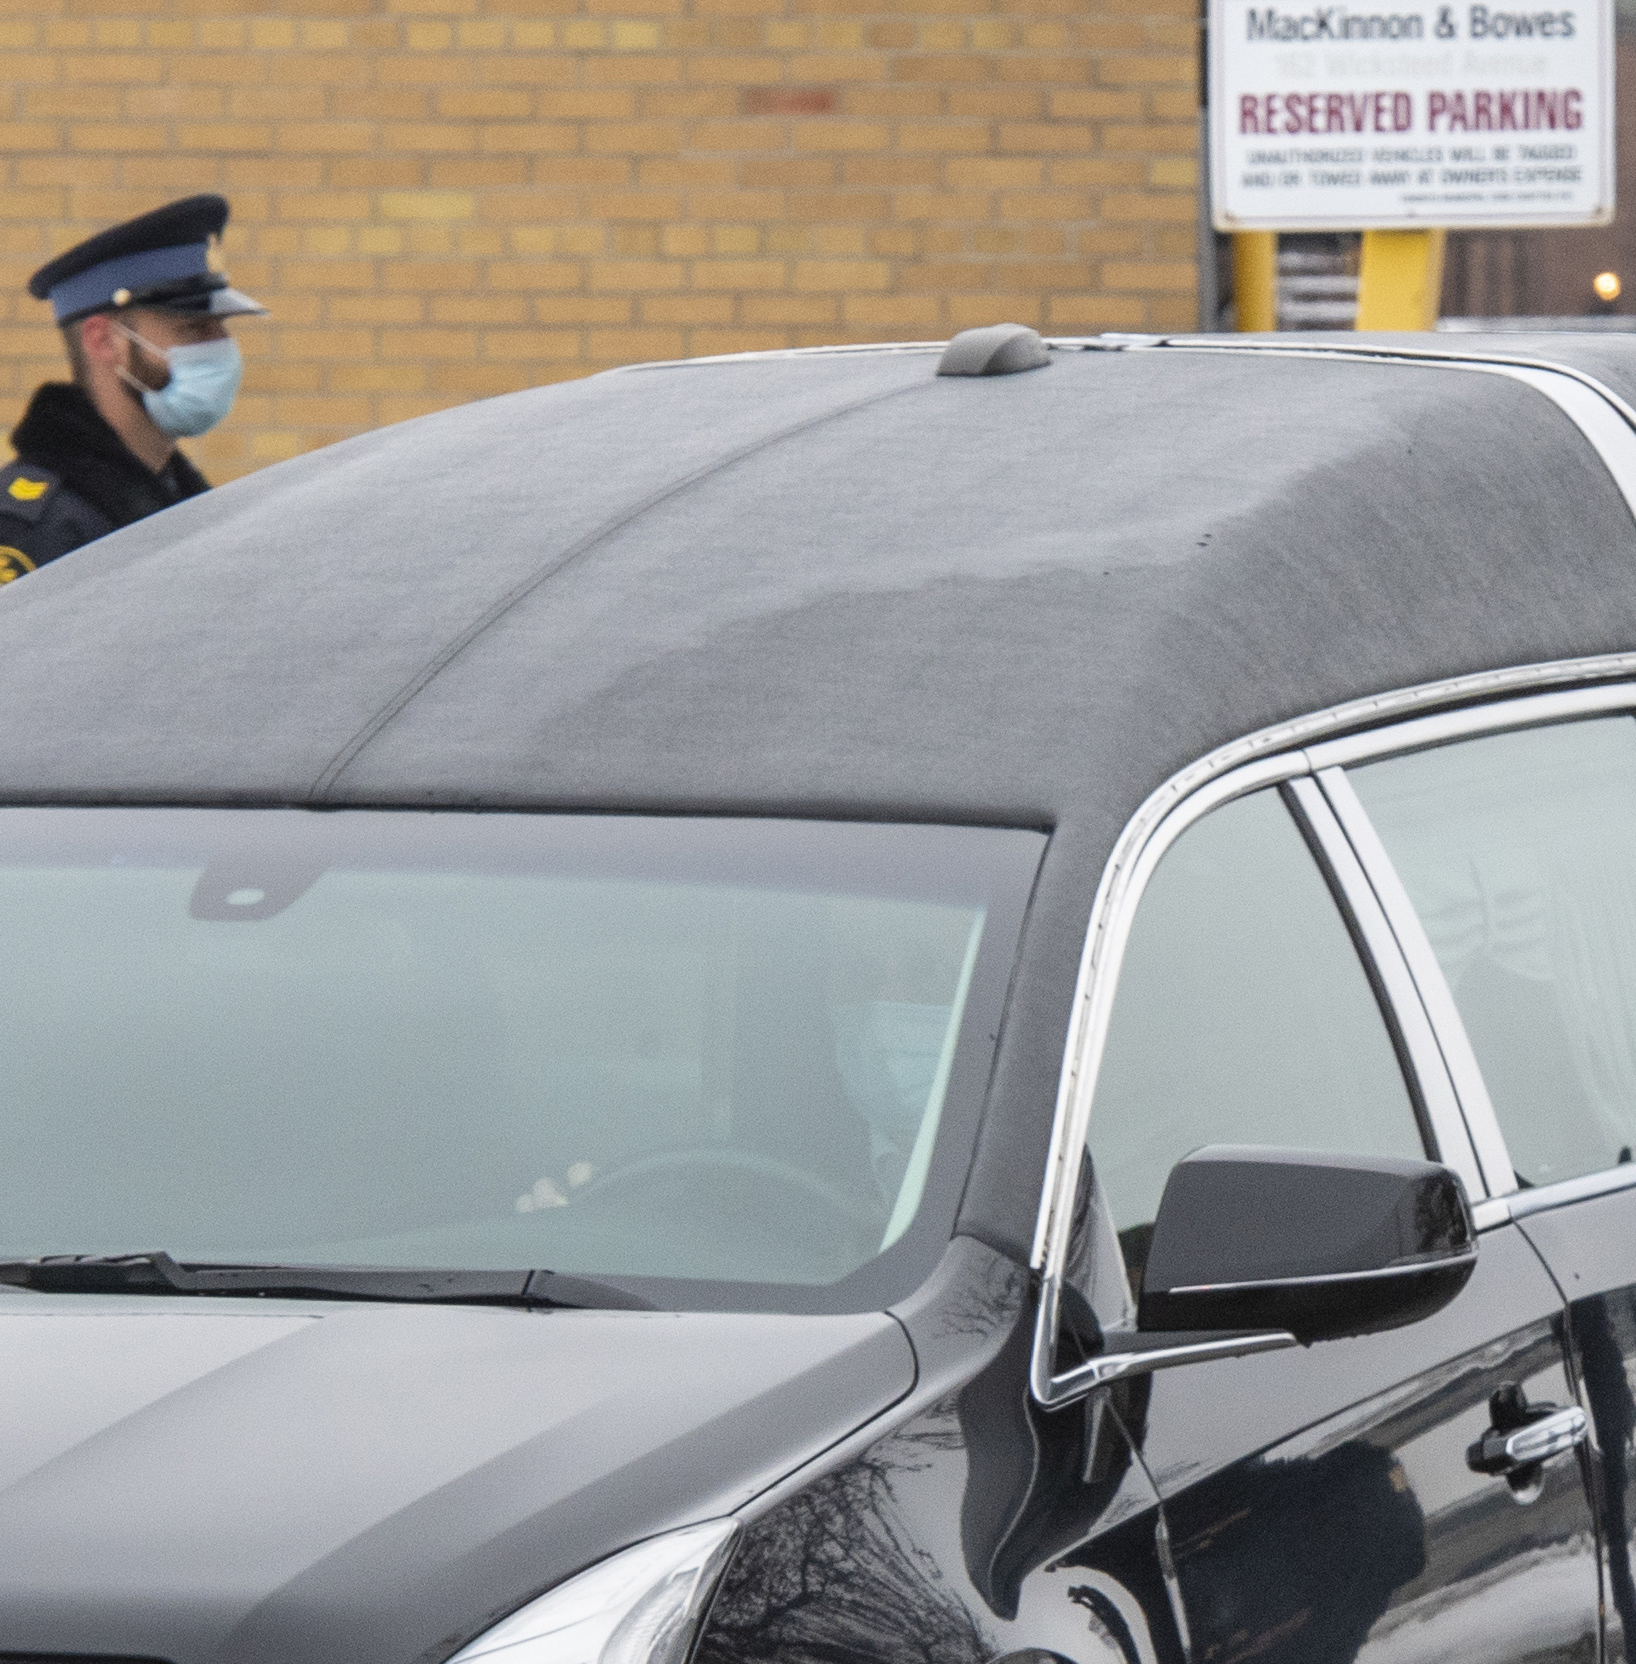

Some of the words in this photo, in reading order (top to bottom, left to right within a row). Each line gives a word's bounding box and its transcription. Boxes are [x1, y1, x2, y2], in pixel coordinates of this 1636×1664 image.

[1246, 8, 1424, 41] MacKinnon
[1434, 5, 1456, 39] &
[1470, 4, 1576, 38] Bowes
[1239, 92, 1412, 134] RESERVED
[1429, 88, 1583, 132] PARKING
